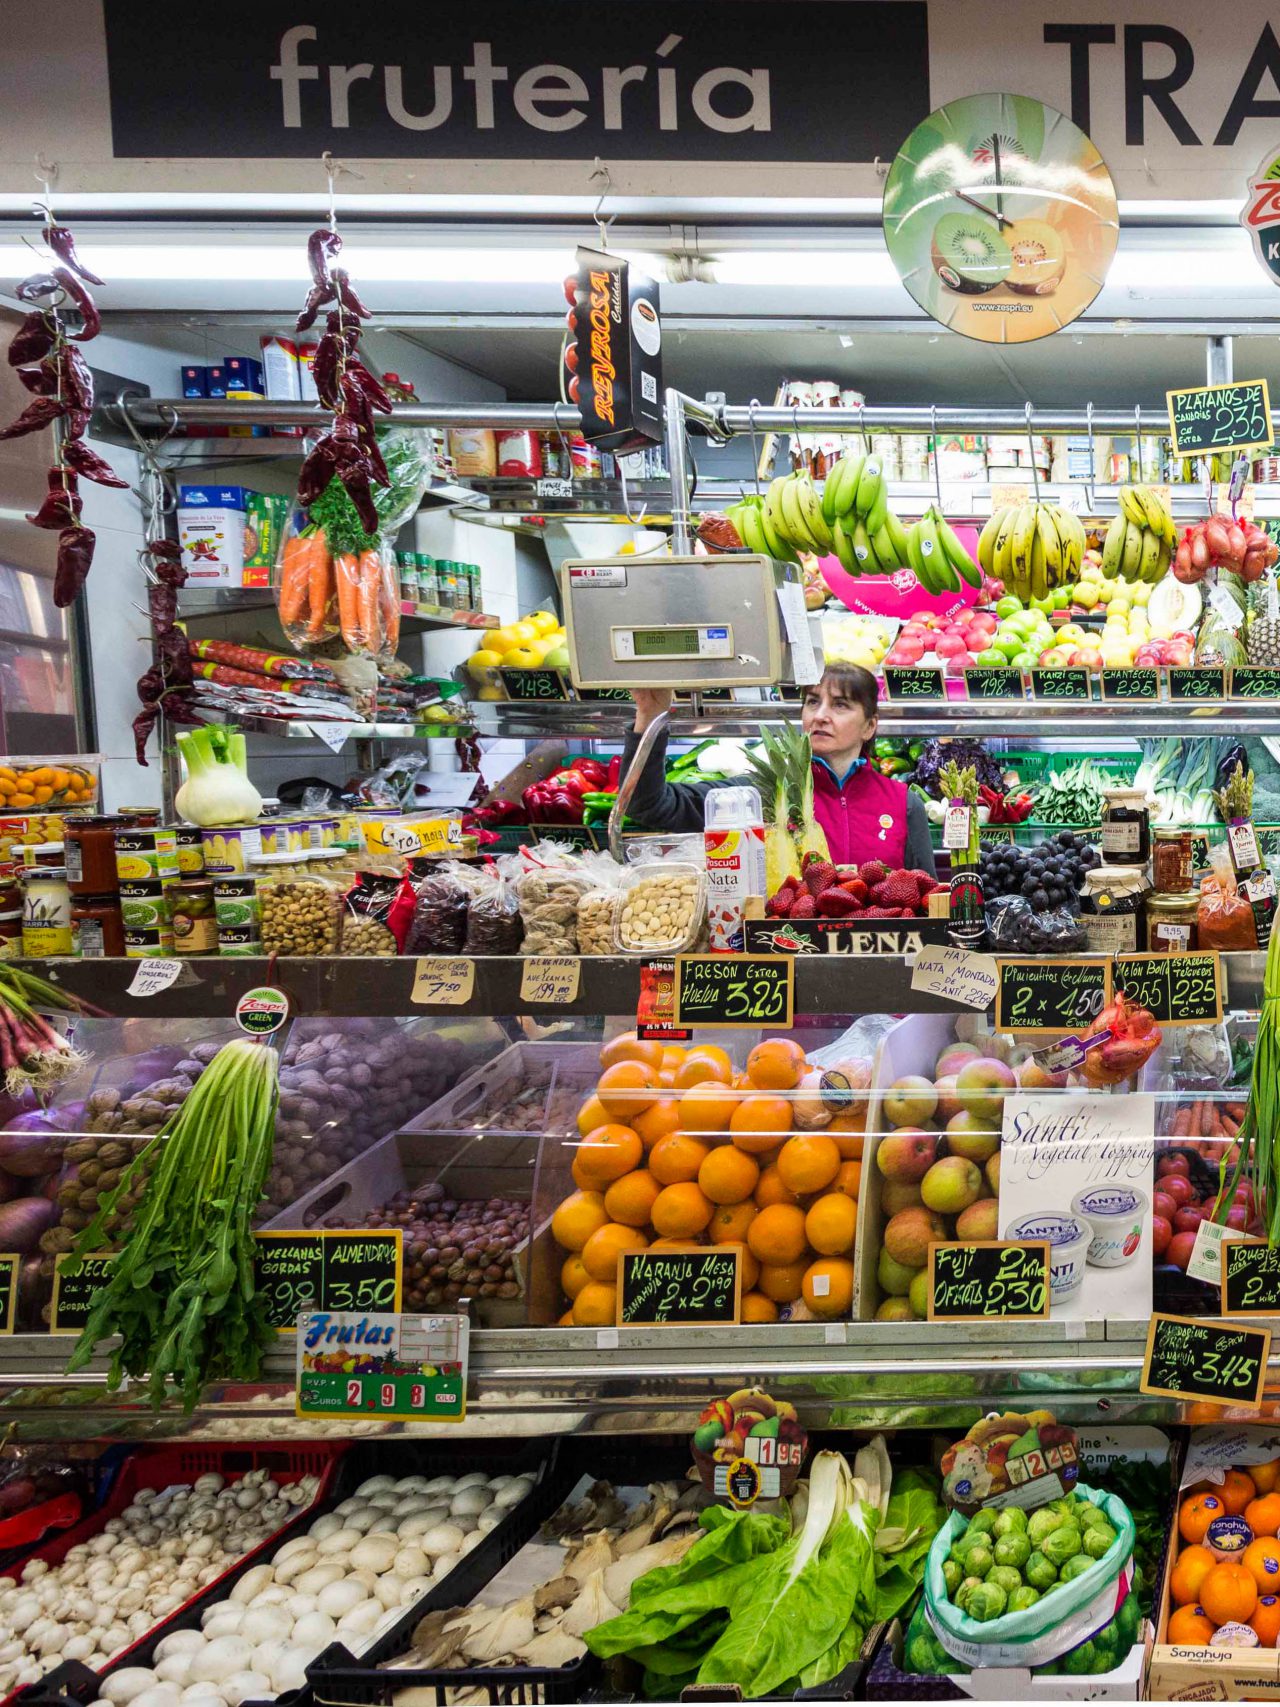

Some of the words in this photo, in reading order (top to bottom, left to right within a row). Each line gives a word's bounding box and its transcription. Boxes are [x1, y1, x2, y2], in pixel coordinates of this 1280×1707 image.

[271, 25, 771, 132] frutería
[611, 271, 622, 324] Calidad
[972, 303, 1033, 313] www.zespri.eu
[590, 271, 616, 427] REYROSA
[1176, 388, 1243, 411] PLATANOS
[1244, 386, 1262, 402] DE
[893, 669, 913, 679] PINK
[916, 669, 936, 679] LADY
[1039, 669, 1067, 680] KANZI
[707, 872, 738, 885] Nata
[826, 931, 924, 954] LENA
[944, 950, 970, 964] HAY
[685, 961, 738, 979] FRESÓN
[917, 961, 945, 974] NATA
[951, 966, 996, 987] MONTADA
[945, 976, 956, 984] DE
[239, 999, 286, 1012] Zespri
[1011, 986, 1033, 1016] 2
[248, 1012, 273, 1022] GREEN
[1001, 1109, 1088, 1144] Santi
[1027, 1140, 1090, 1180] Vegetal
[1016, 1226, 1064, 1236] SANTI
[1230, 1245, 1279, 1261] Tomate
[261, 1262, 312, 1275] GORDAS
[631, 1254, 692, 1281] NARANJA
[700, 1255, 735, 1276] MESA
[995, 1247, 1026, 1281] 2
[660, 1283, 679, 1311] 2
[1242, 1277, 1263, 1305] 2
[303, 1314, 396, 1349] Frutas
[962, 1643, 978, 1656] life
[1170, 1647, 1233, 1661] Sanahuja
